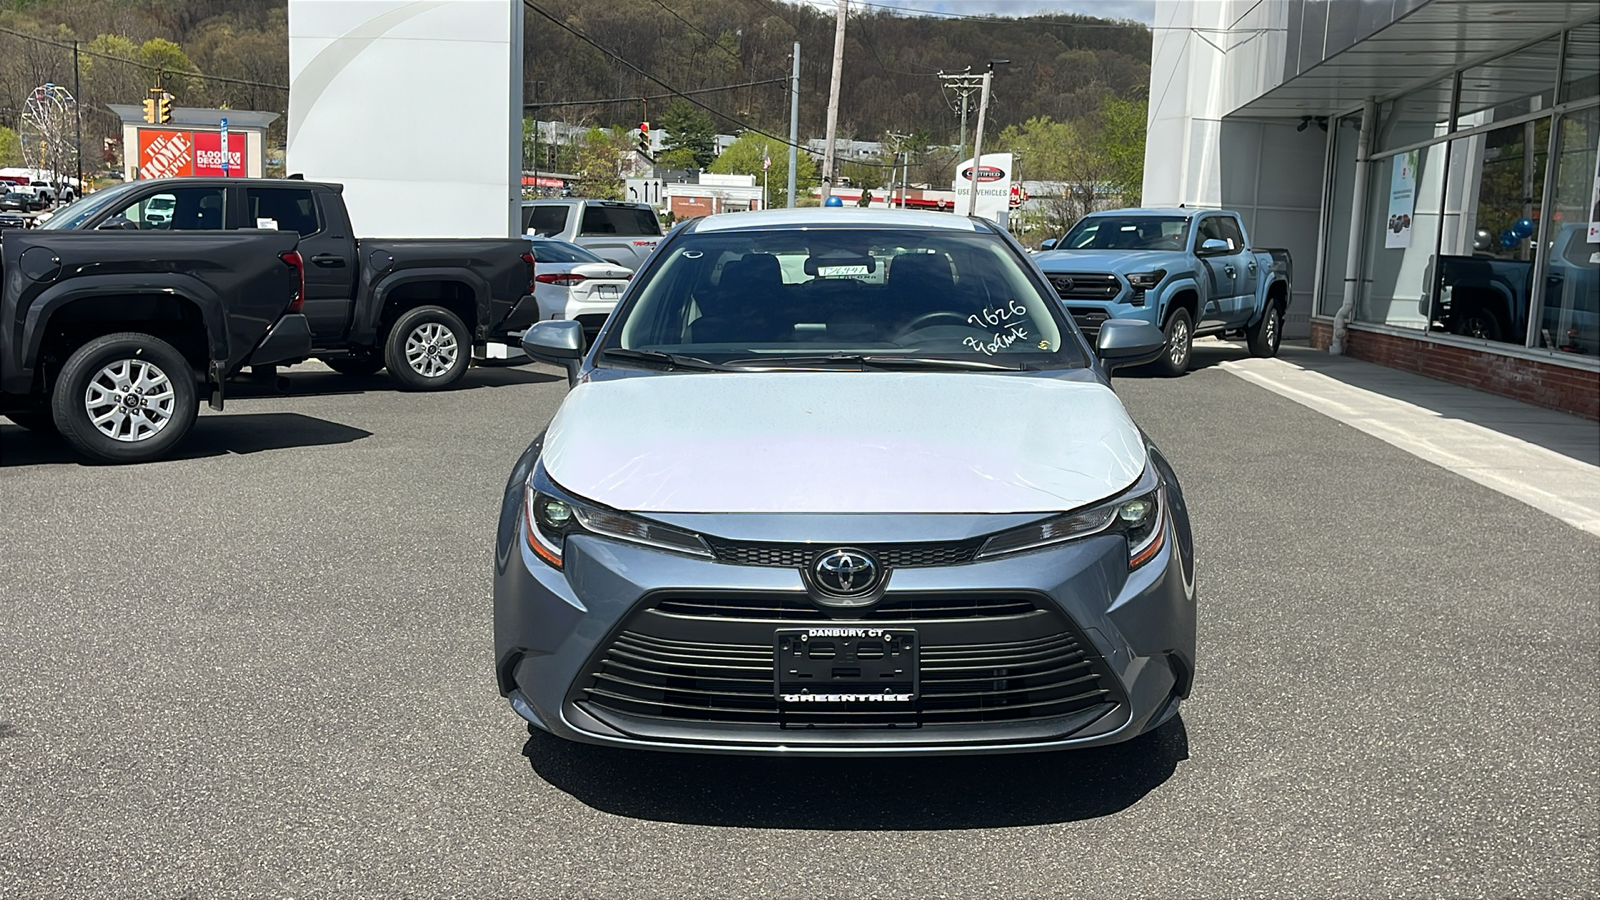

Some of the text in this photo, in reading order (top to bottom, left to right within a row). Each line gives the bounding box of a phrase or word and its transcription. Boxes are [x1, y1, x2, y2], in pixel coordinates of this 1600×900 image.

[144, 134, 168, 157] THE
[140, 132, 191, 179] HOME
[196, 150, 221, 158] FLOO
[957, 188, 1008, 197] USE VEHICLES
[808, 629, 884, 638] DANBURY, CT
[783, 694, 910, 702] GREENTREE
